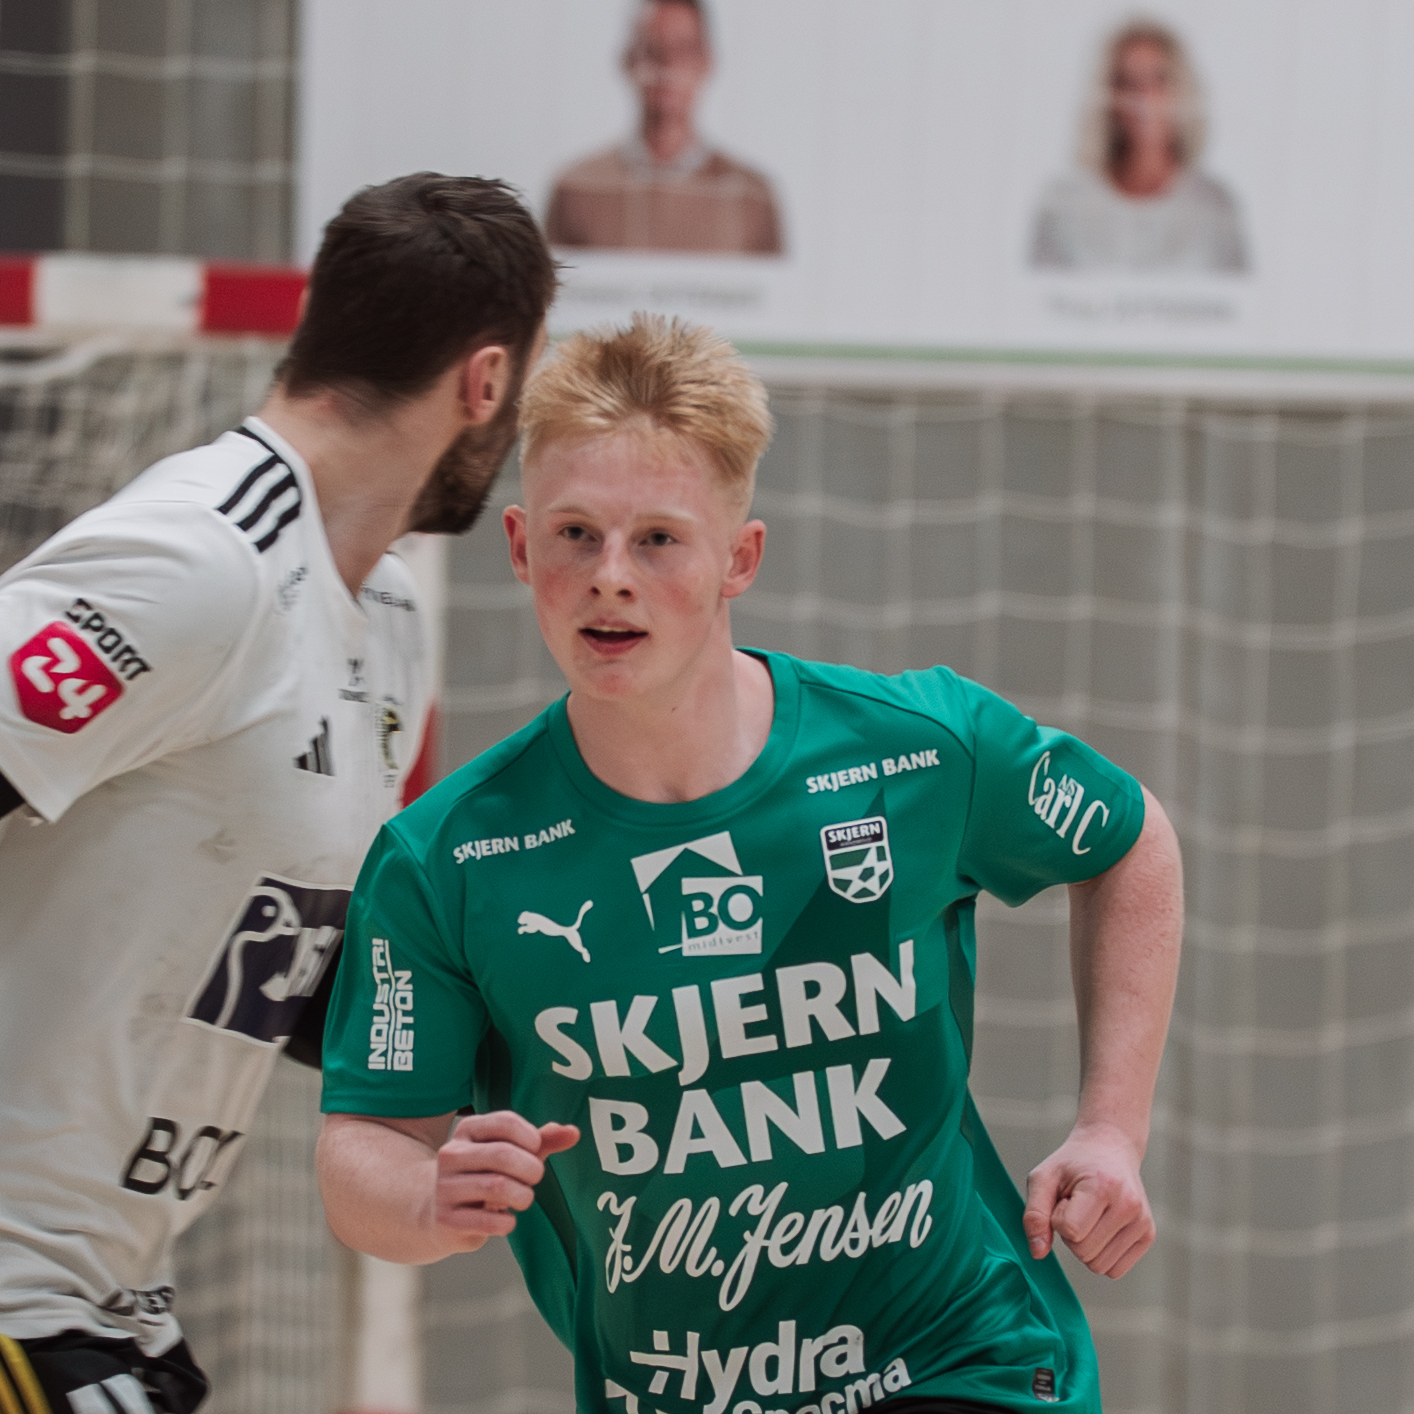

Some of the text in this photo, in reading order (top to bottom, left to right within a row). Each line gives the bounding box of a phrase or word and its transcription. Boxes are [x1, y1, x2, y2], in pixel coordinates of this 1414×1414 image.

[21, 637, 107, 720] 24
[65, 598, 152, 681] SPORT
[806, 749, 940, 794] SKJERN BANK
[1028, 750, 1110, 855] Carl C
[453, 819, 576, 864] SKJERN BANK
[827, 822, 882, 843] SKJERN
[683, 884, 764, 940] BO
[368, 938, 390, 1070] INDUSTRI
[393, 970, 415, 1072] BETON
[534, 939, 918, 1087] SKJERN
[588, 1058, 907, 1175] BANK
